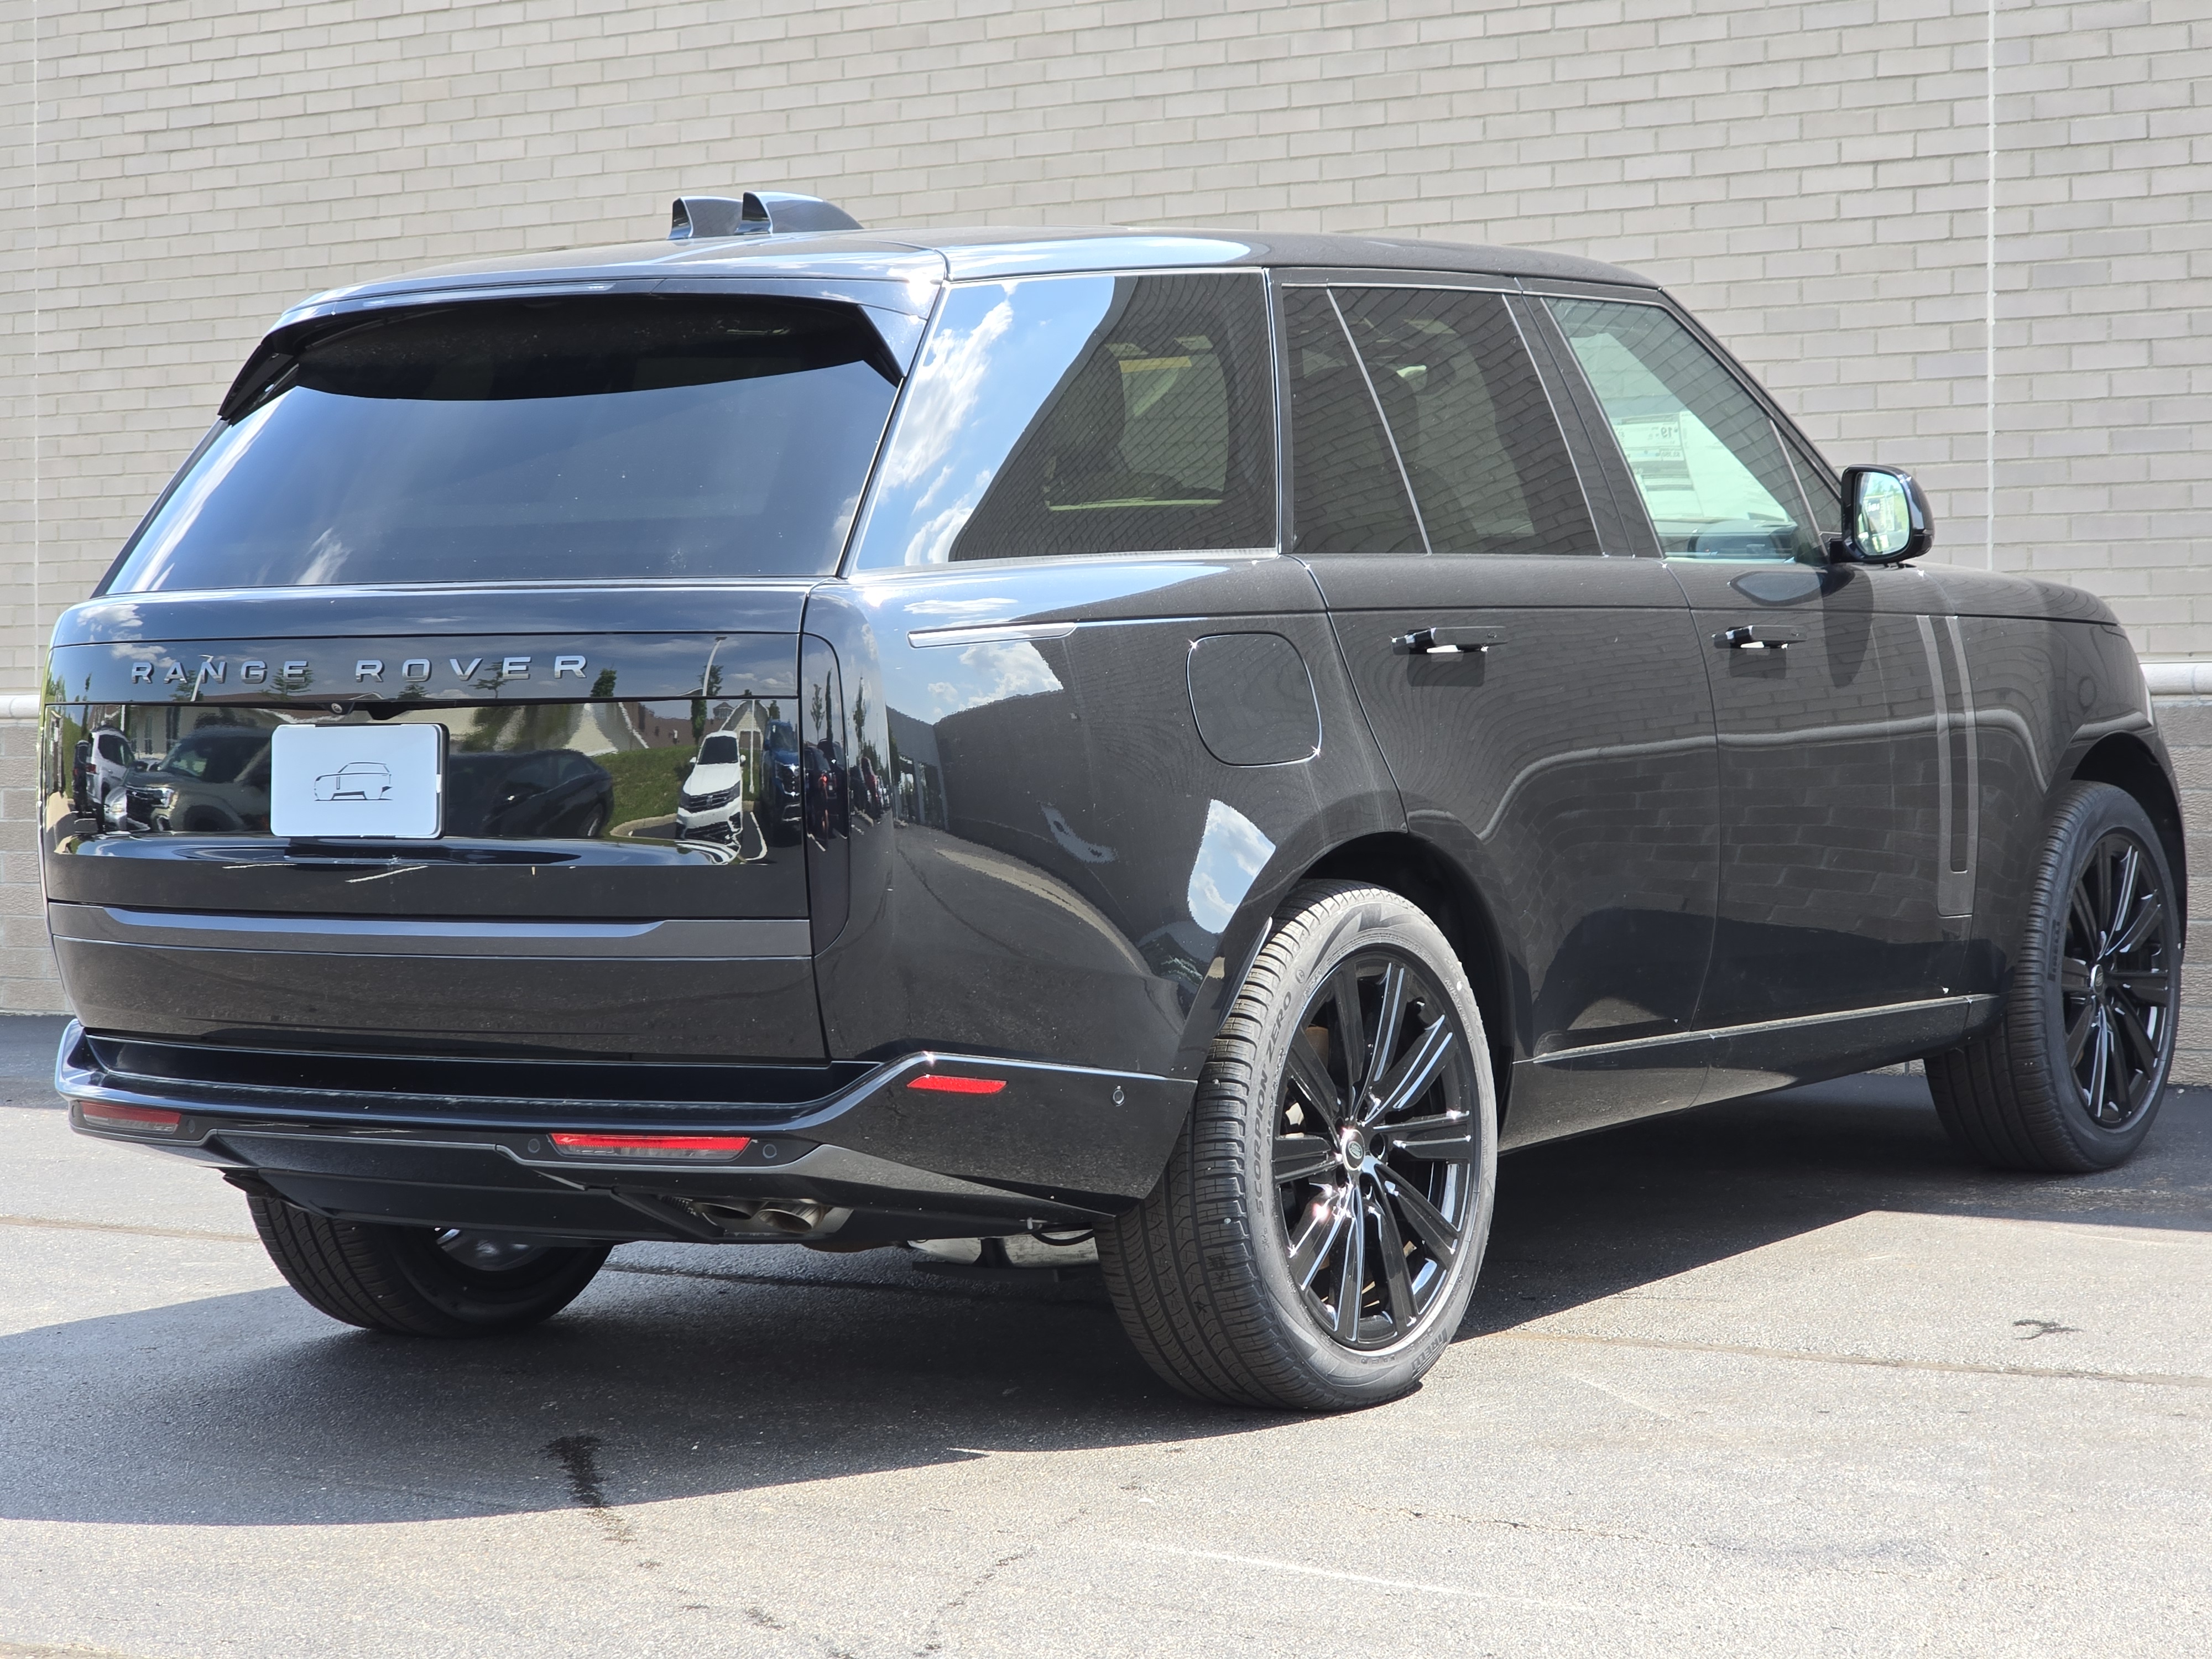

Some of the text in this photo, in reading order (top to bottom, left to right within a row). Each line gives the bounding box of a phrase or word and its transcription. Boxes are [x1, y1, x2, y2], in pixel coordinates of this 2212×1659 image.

[131, 655, 588, 684] RANGE ROVER
[1253, 1070, 1267, 1217] SCORPION
[1266, 991, 1292, 1063] ZERO
[1411, 1327, 1448, 1378] PIRELLI
